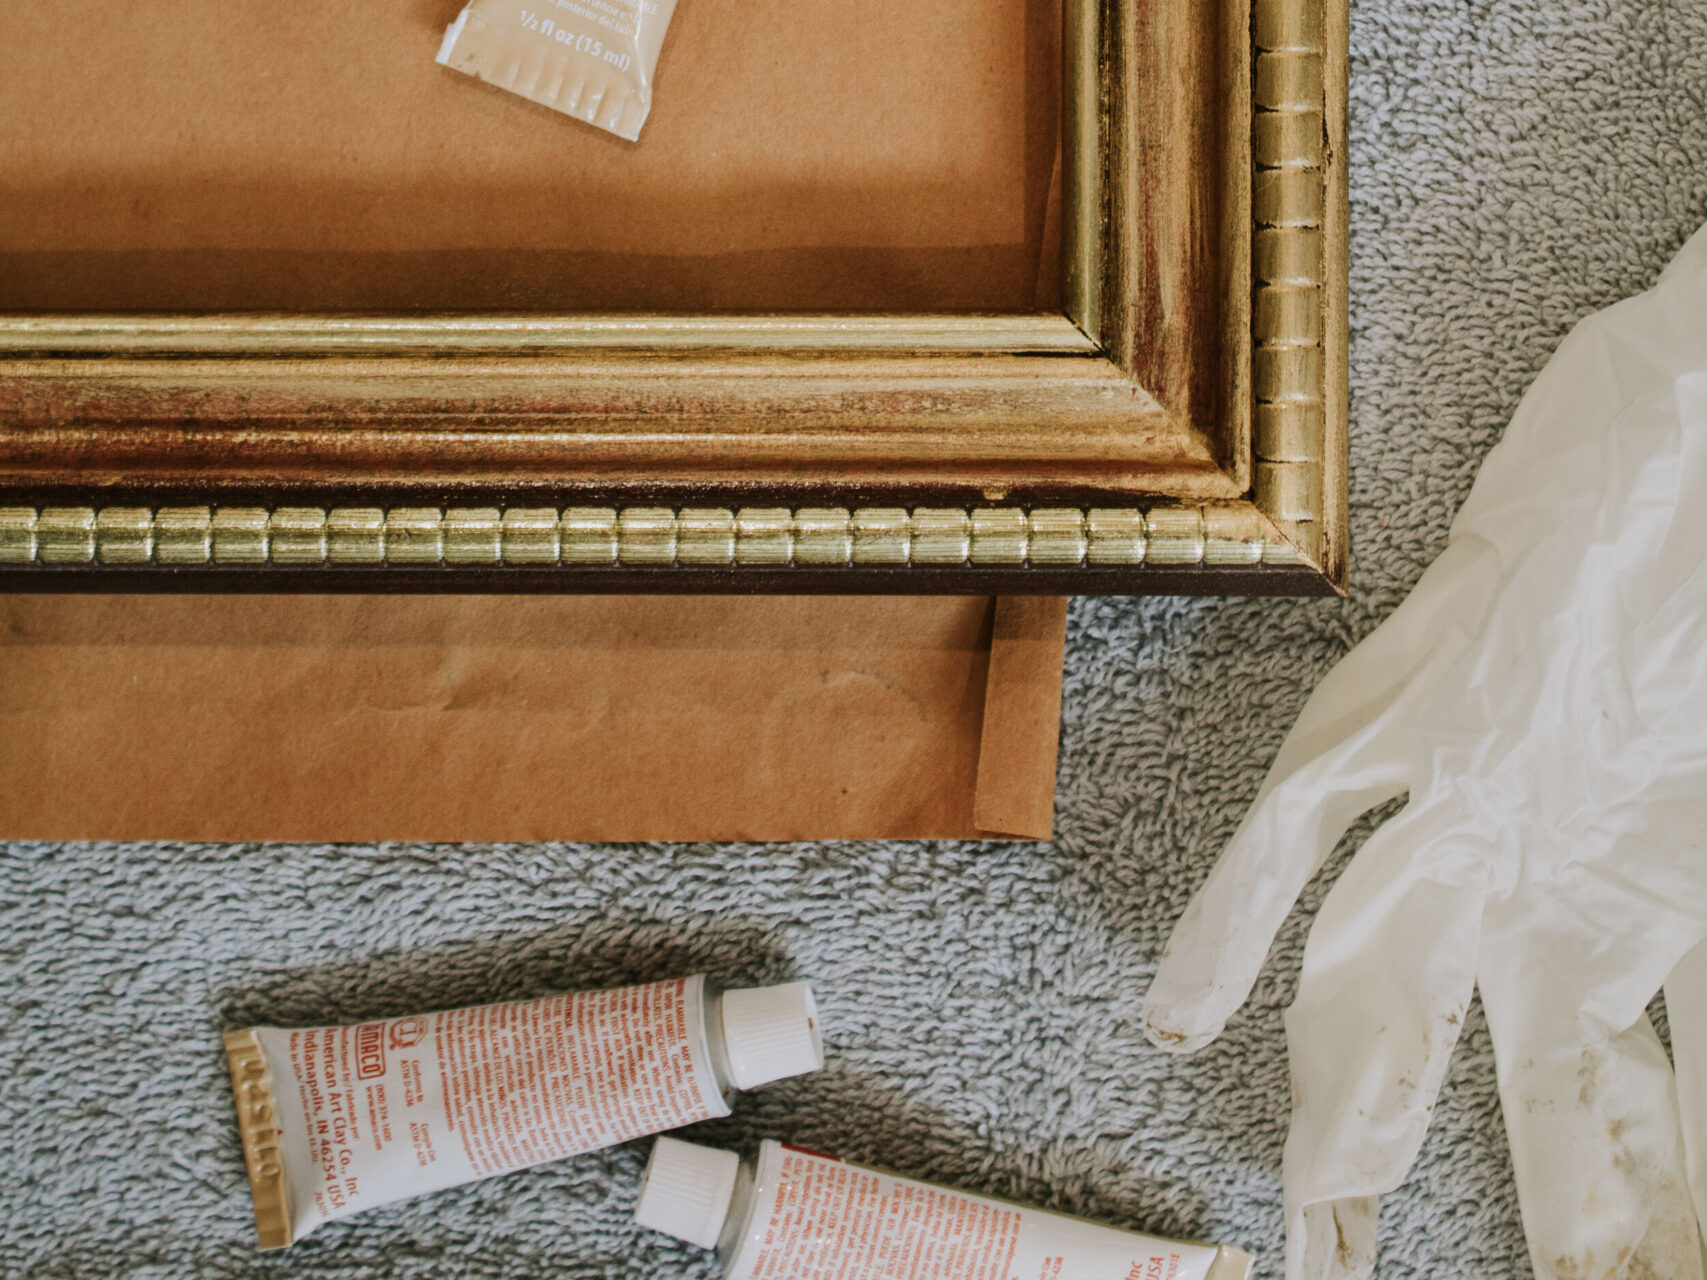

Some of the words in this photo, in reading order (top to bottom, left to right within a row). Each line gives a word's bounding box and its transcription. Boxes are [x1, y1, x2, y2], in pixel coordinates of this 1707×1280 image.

[597, 14, 615, 29] del
[540, 18, 555, 37] fl
[554, 28, 575, 46] oz
[575, 33, 603, 57] (15
[603, 49, 631, 73] ml)
[322, 1027, 348, 1088] American
[400, 1058, 410, 1079] ASTM
[295, 1029, 334, 1115] Indianapolis,
[328, 1091, 343, 1113] Art
[317, 1118, 329, 1134] IN
[332, 1116, 347, 1145] Clay
[320, 1138, 337, 1182] 46254
[337, 1147, 353, 1174] Co.,
[326, 1183, 345, 1208] USA
[343, 1175, 358, 1196] Inc
